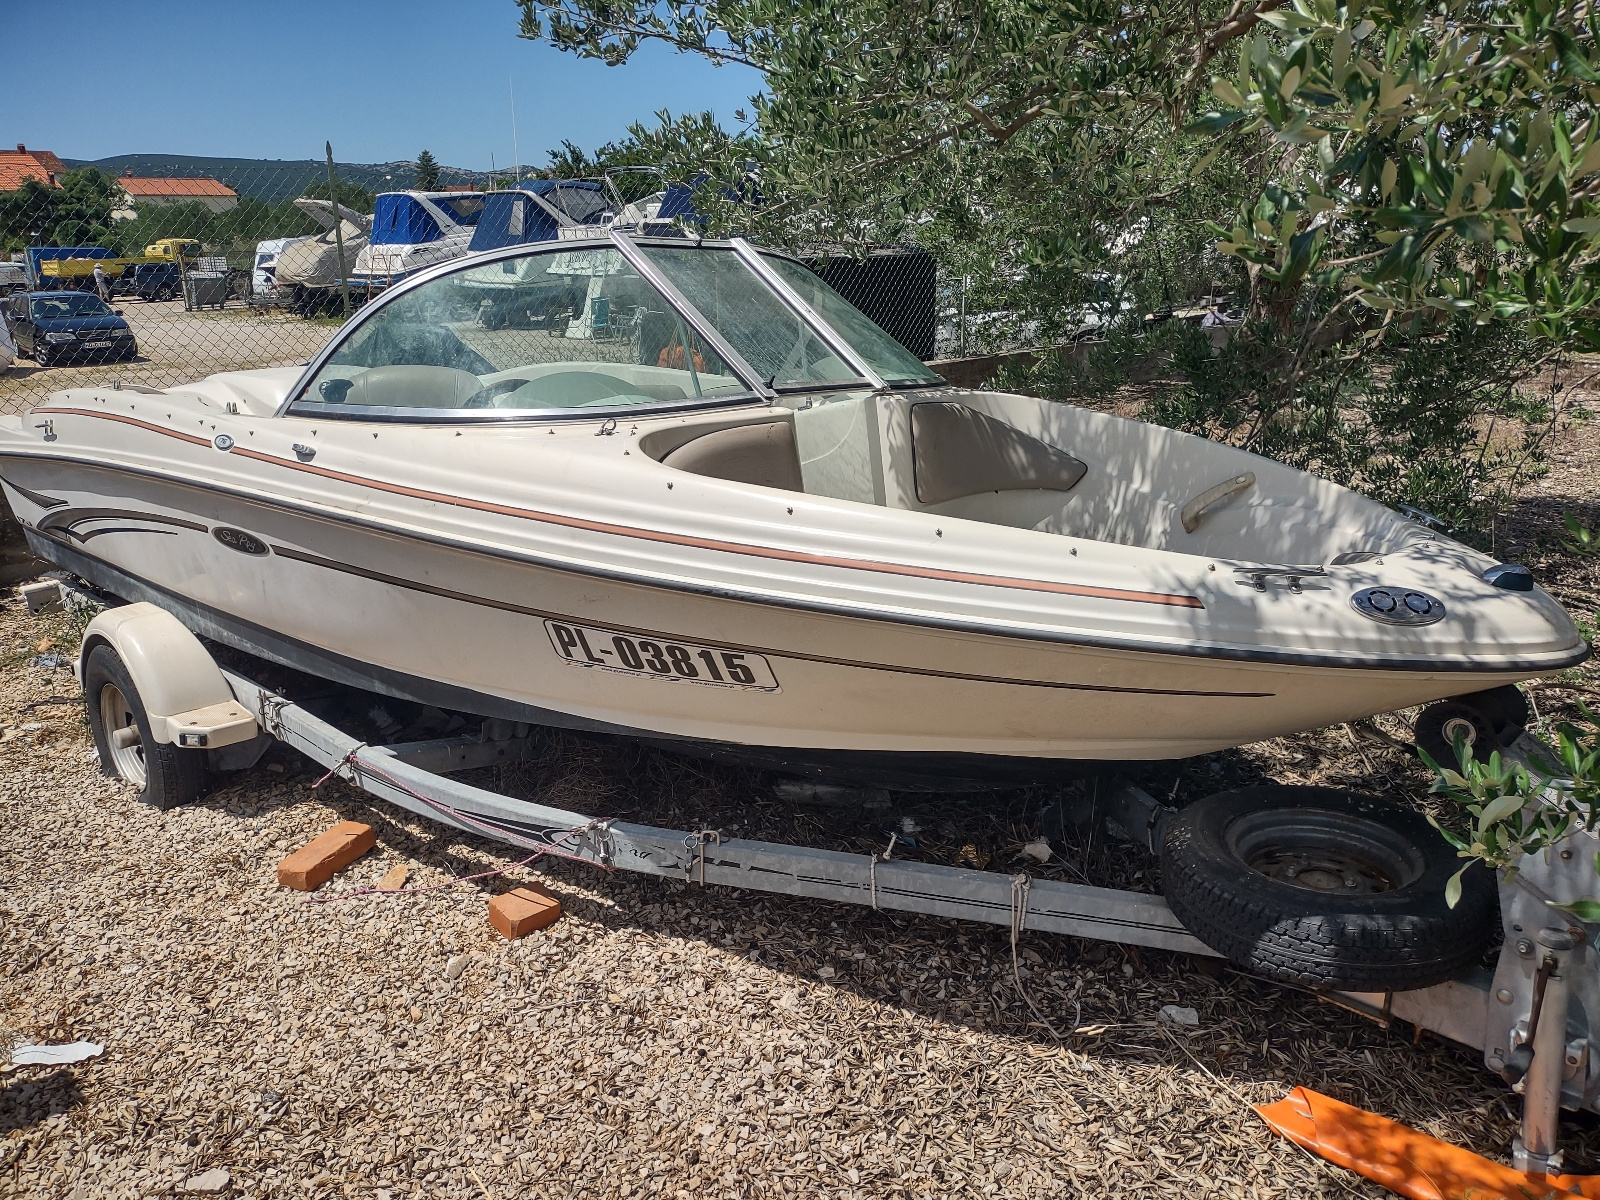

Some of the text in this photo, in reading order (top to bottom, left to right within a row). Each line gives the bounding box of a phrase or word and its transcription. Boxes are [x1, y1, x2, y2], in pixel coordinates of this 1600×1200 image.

[221, 530, 256, 553] Sea Ray
[551, 622, 757, 685] PL-03815
